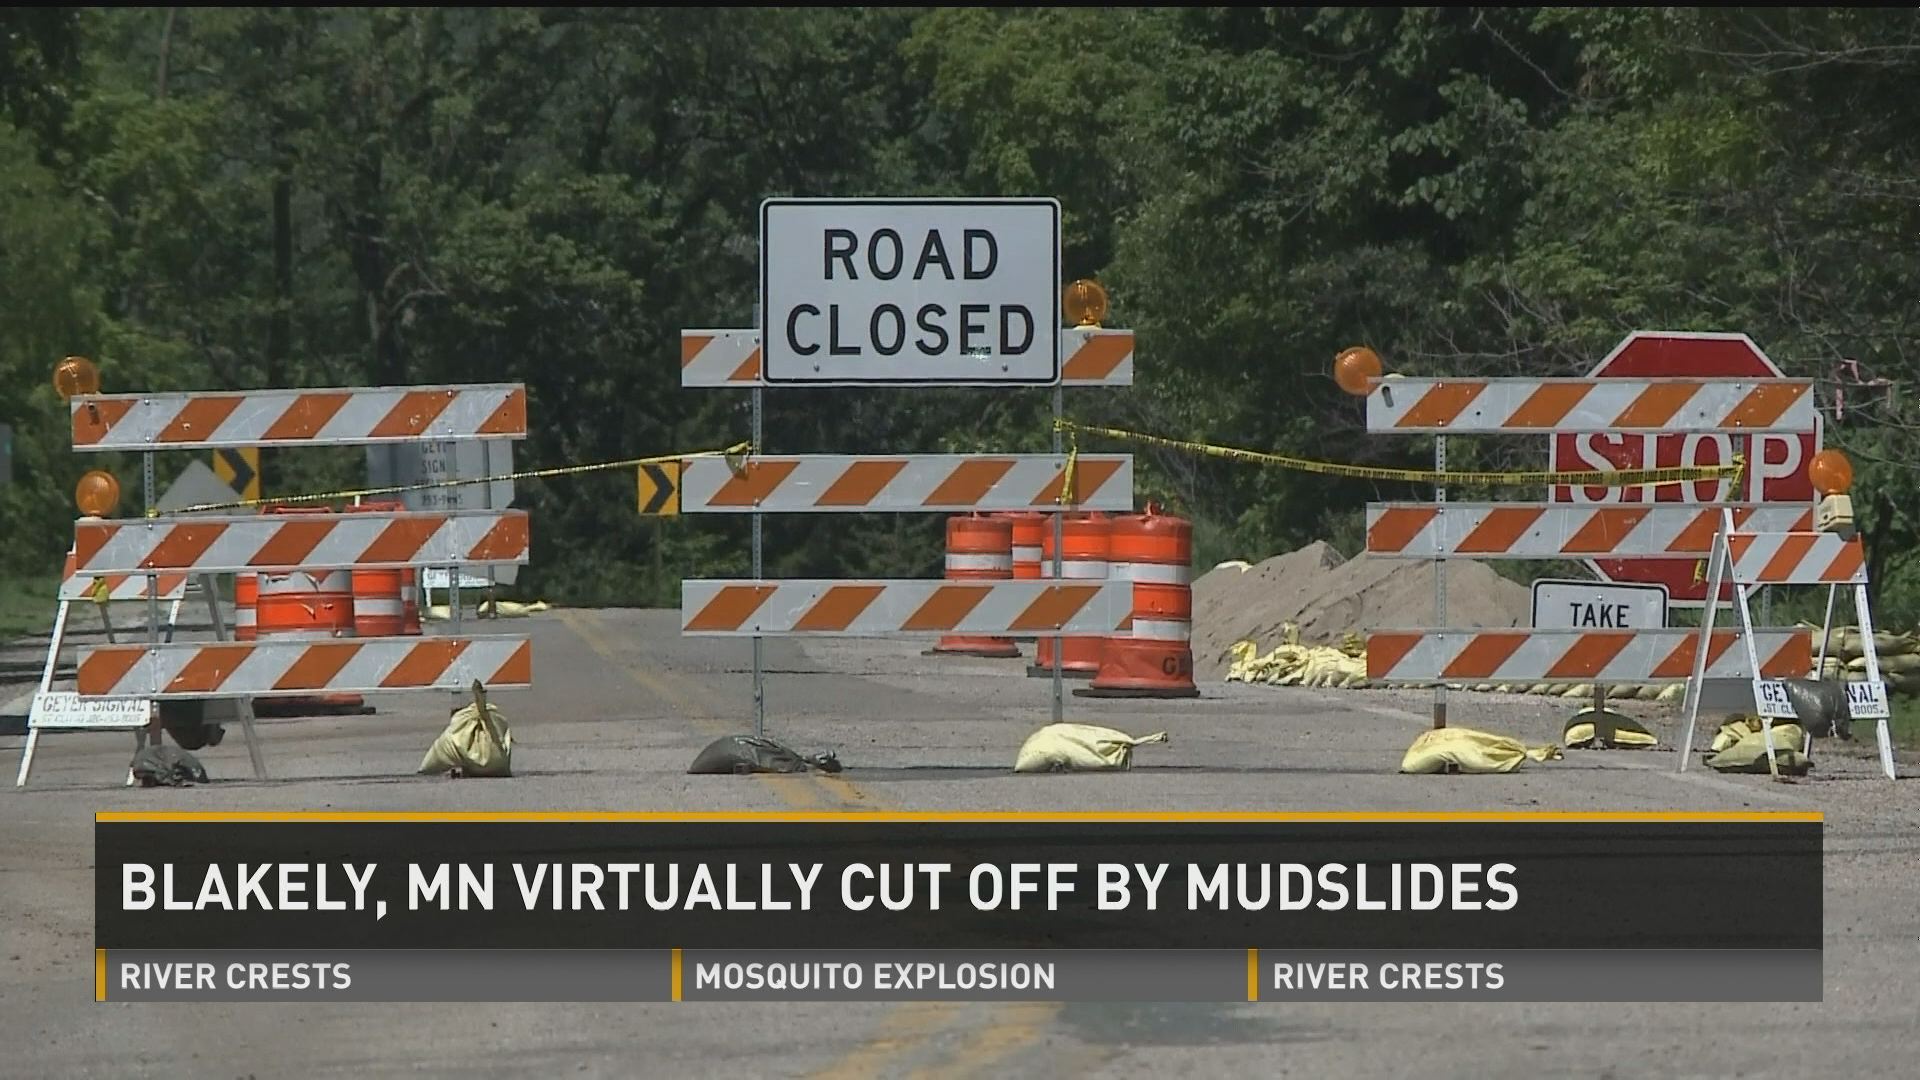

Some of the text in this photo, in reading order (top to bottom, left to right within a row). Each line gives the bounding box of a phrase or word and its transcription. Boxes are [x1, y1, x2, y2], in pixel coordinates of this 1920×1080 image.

[824, 229, 998, 281] ROAD
[786, 303, 1035, 356] CLOSED
[1569, 433, 1802, 503] STOP
[1570, 602, 1630, 627] TAKE
